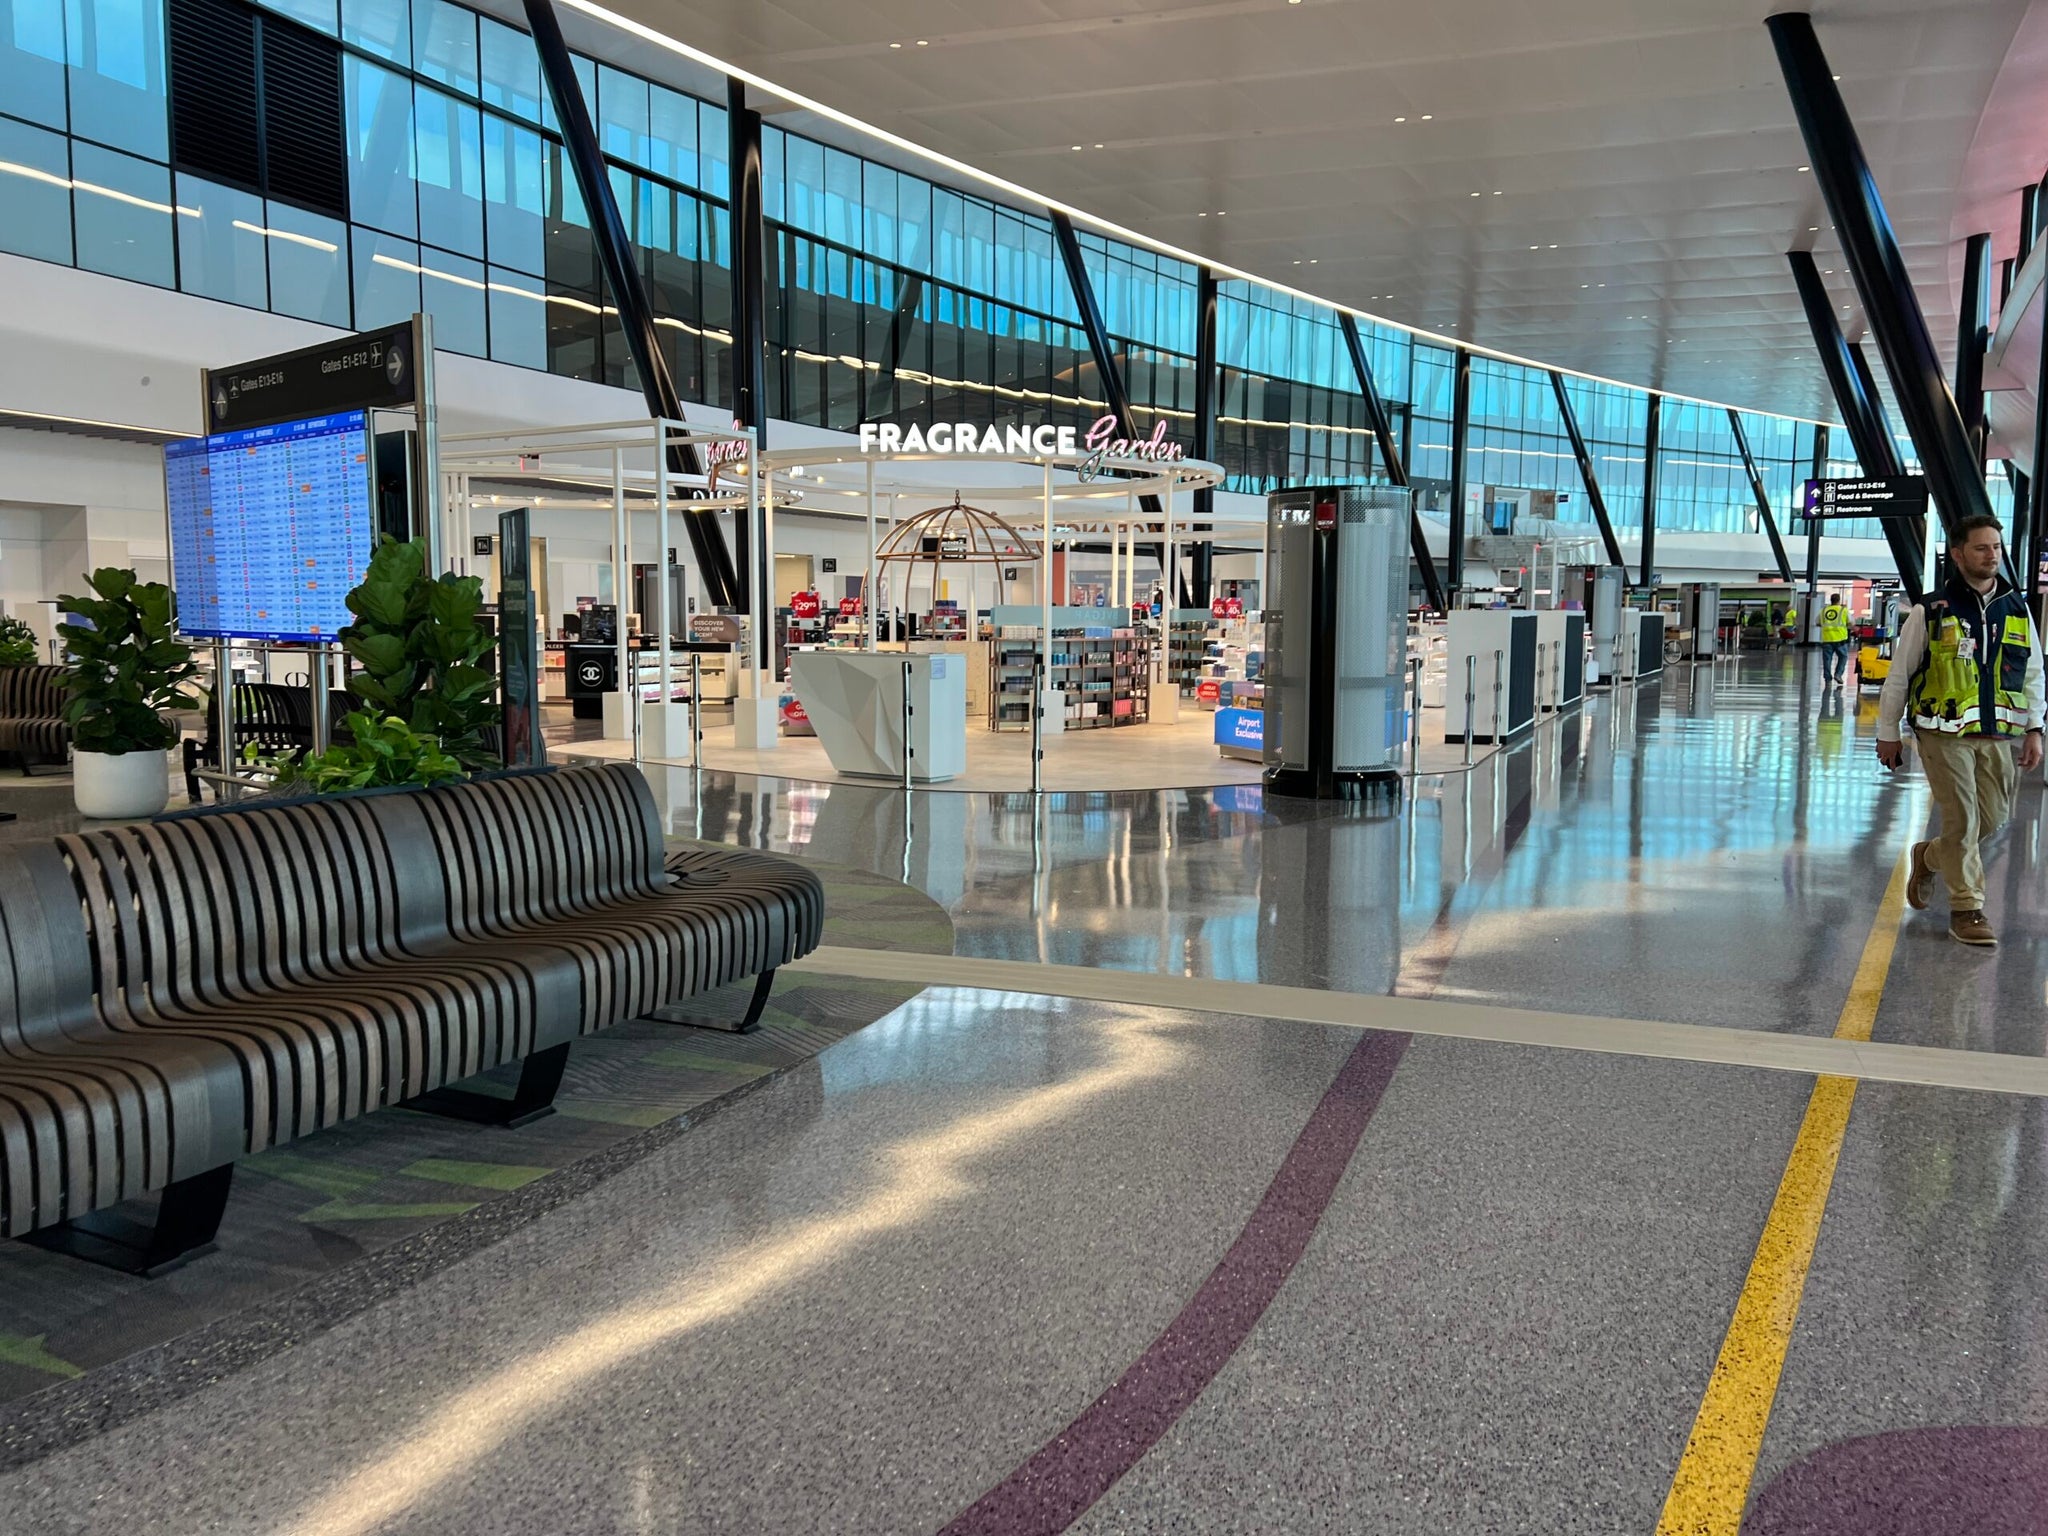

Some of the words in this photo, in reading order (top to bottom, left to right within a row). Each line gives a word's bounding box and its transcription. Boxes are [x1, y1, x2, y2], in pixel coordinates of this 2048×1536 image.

[321, 358, 343, 374] Gates
[343, 352, 368, 370] E1-E12
[240, 377, 258, 392] Gates
[258, 371, 284, 389] E13-E16
[859, 422, 1077, 455] FRAGRANCE
[1078, 414, 1187, 483] Garden
[1234, 726, 1264, 740] Exclusive
[1238, 716, 1260, 732] Airport
